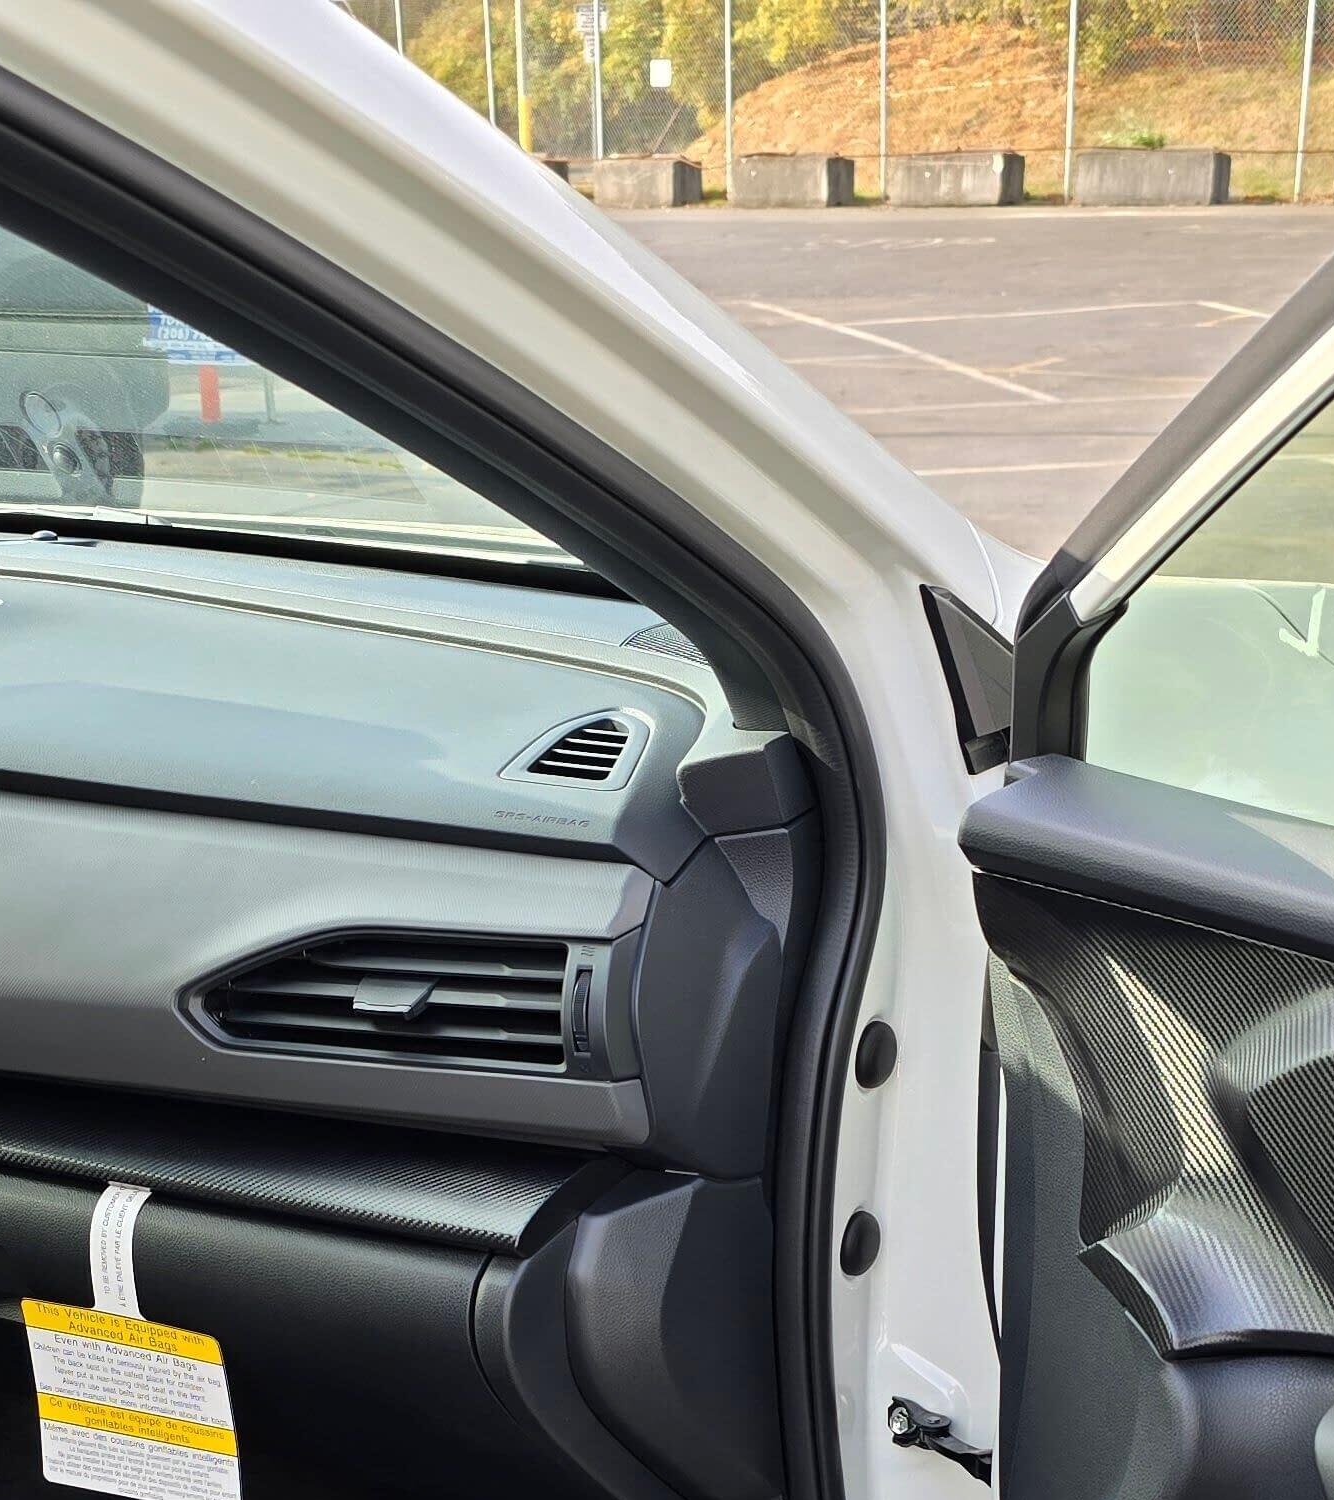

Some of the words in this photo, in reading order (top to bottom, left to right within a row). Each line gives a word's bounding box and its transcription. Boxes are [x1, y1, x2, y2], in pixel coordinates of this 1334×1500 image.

[35, 1303, 59, 1316] This
[64, 1309, 105, 1325] Vehicle
[125, 1320, 177, 1340] Equipped
[180, 1333, 204, 1346] with
[68, 1321, 123, 1340] Advanced
[129, 1333, 143, 1344] Air
[149, 1337, 178, 1353] Bags
[54, 1334, 77, 1346] Even
[82, 1340, 101, 1351] with
[105, 1344, 151, 1361] Advanced
[155, 1354, 168, 1364] Air
[173, 1358, 197, 1372] Bags
